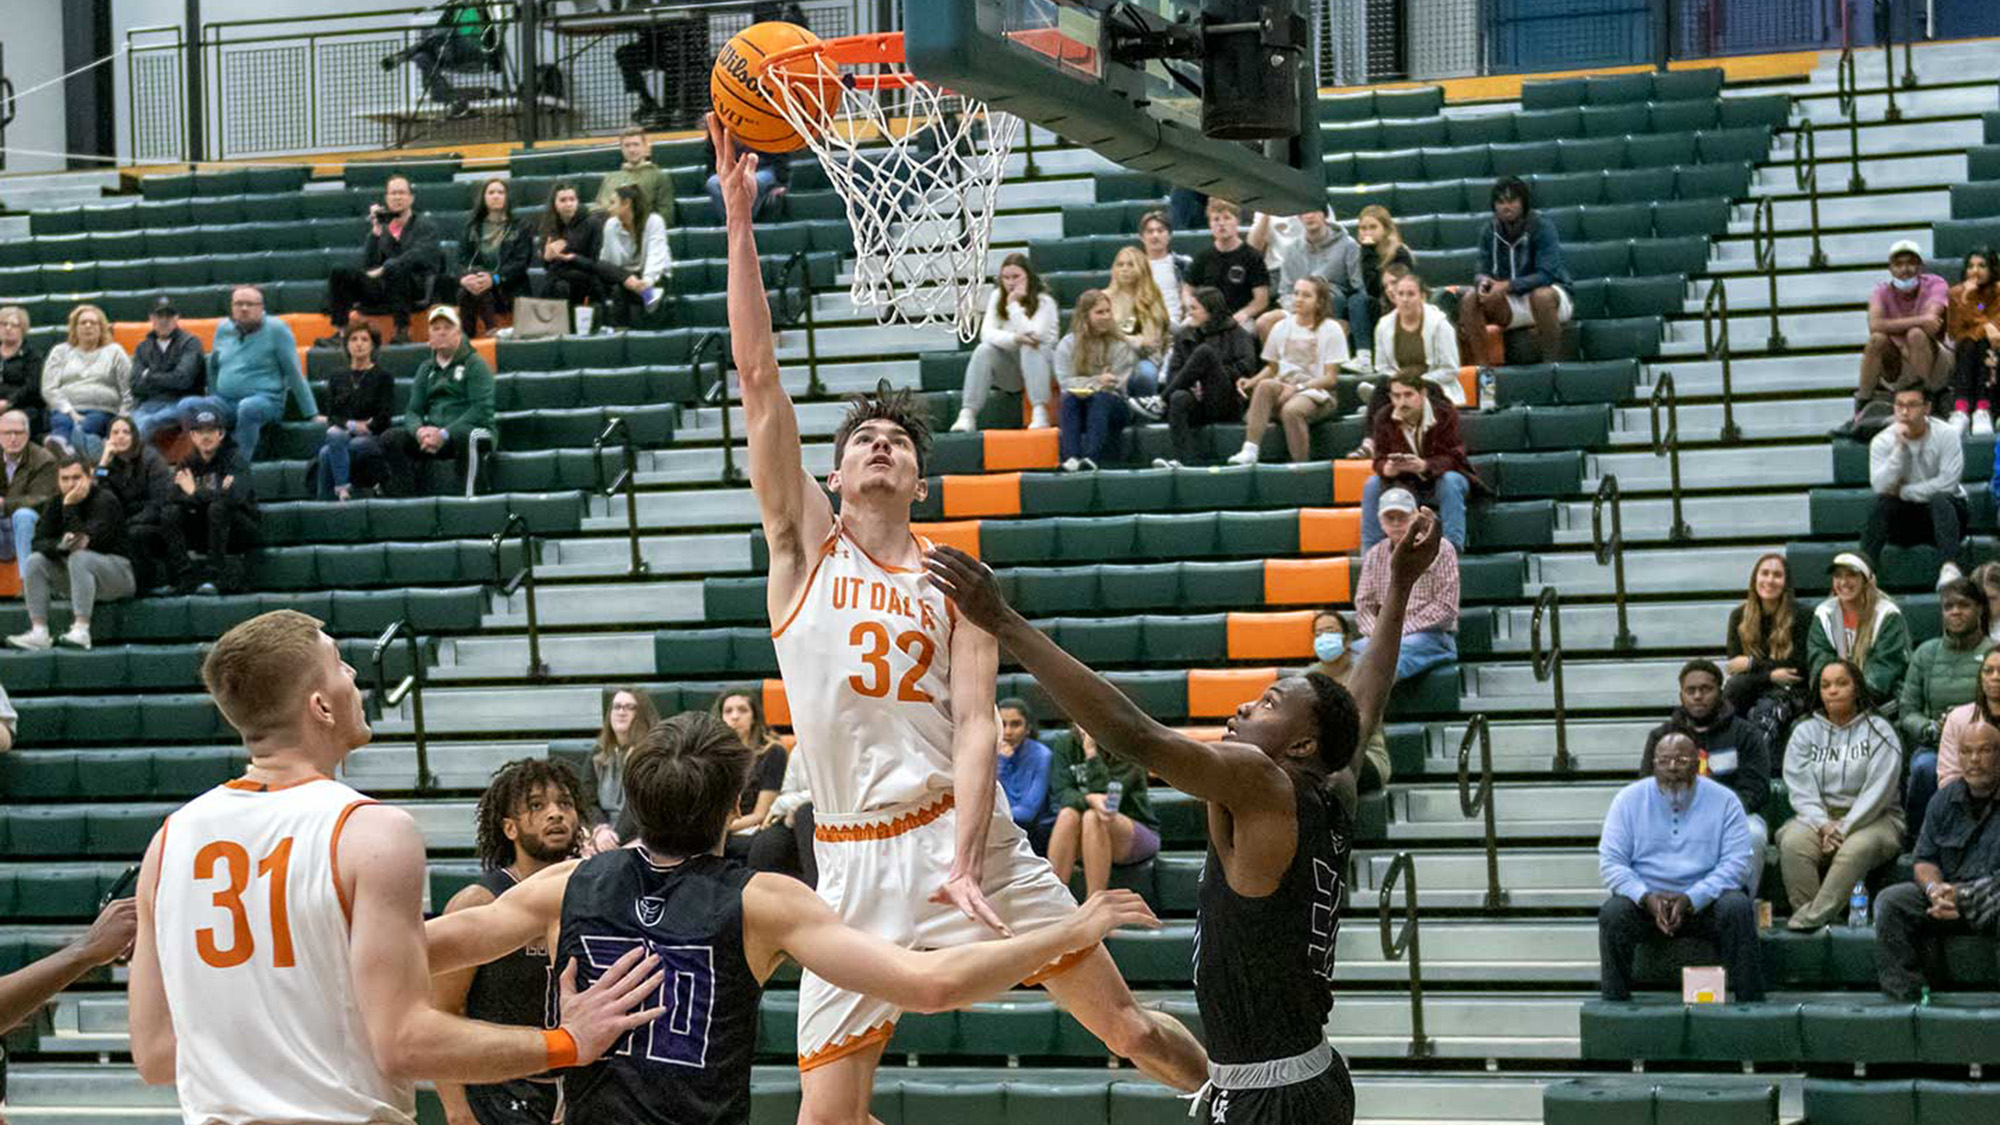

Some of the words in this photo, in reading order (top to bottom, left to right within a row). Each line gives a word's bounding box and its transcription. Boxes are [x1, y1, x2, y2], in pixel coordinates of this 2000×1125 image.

[719, 45, 774, 104] Wilson
[833, 577, 864, 610] UT
[849, 621, 934, 702] 32
[1811, 741, 1869, 762] SENOR
[194, 837, 295, 968] 31
